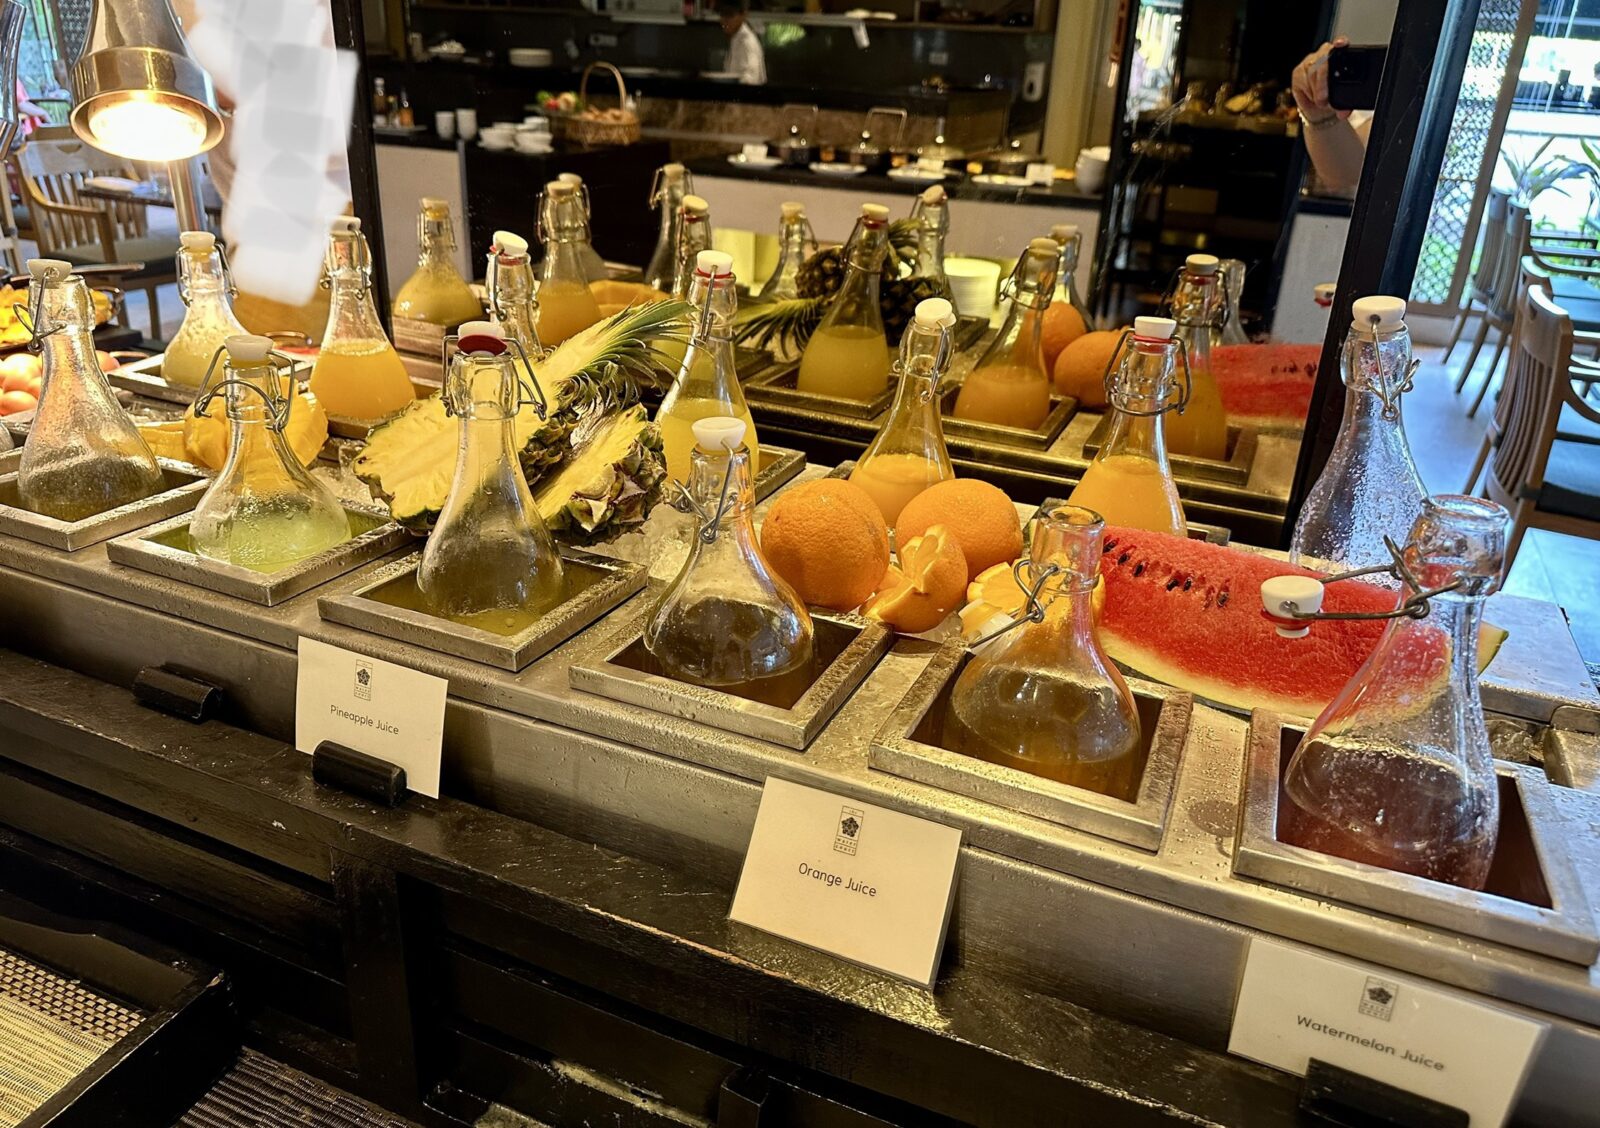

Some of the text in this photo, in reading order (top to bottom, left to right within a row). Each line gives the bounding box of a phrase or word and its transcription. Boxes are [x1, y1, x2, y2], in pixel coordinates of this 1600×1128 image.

[330, 704, 400, 735] Pineapple Juice
[798, 862, 877, 897] Orange Juice
[1296, 1015, 1445, 1072] Watermelon Juice
